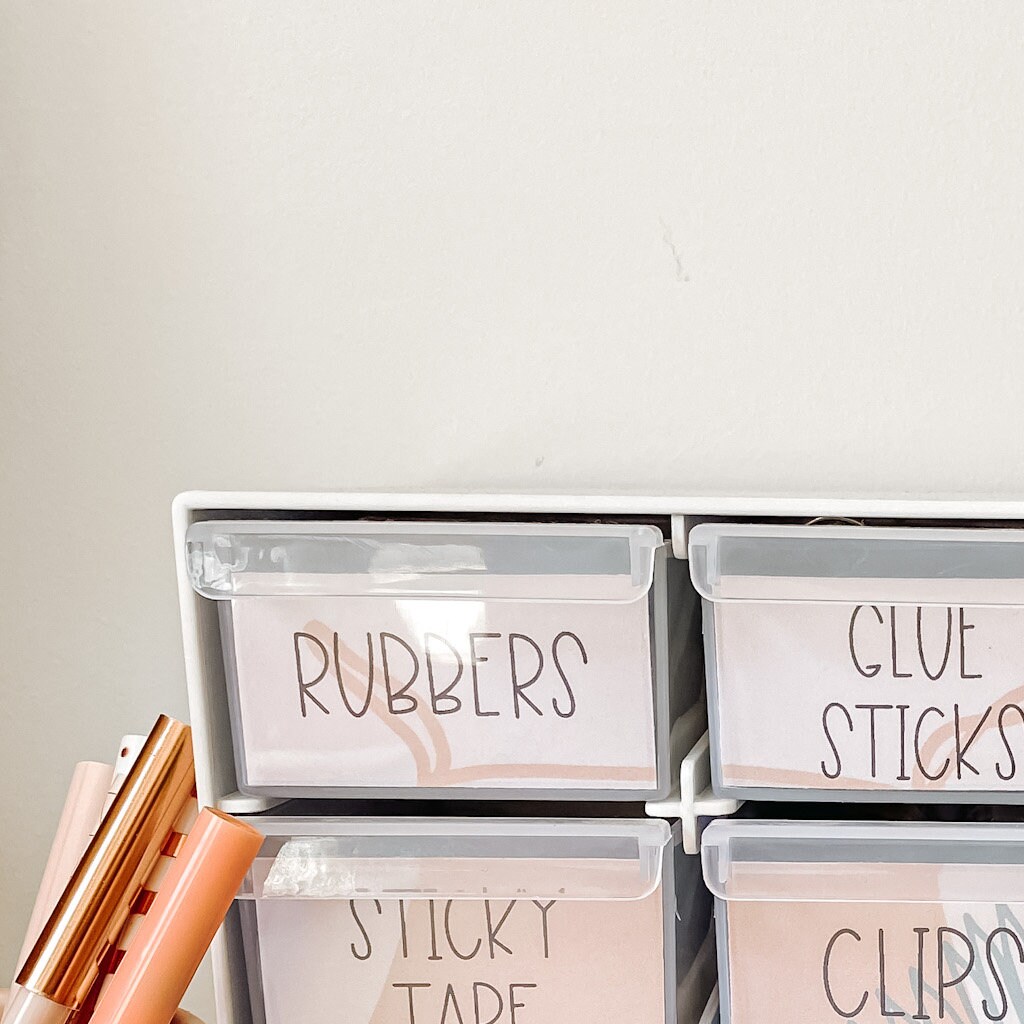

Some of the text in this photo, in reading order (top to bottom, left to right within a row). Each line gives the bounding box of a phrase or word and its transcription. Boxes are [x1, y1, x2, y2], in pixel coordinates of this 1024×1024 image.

[294, 631, 588, 719] RUBBERS
[848, 605, 983, 681] GLUE
[349, 888, 565, 961] STICKY
[823, 927, 1024, 1021] CLIPS
